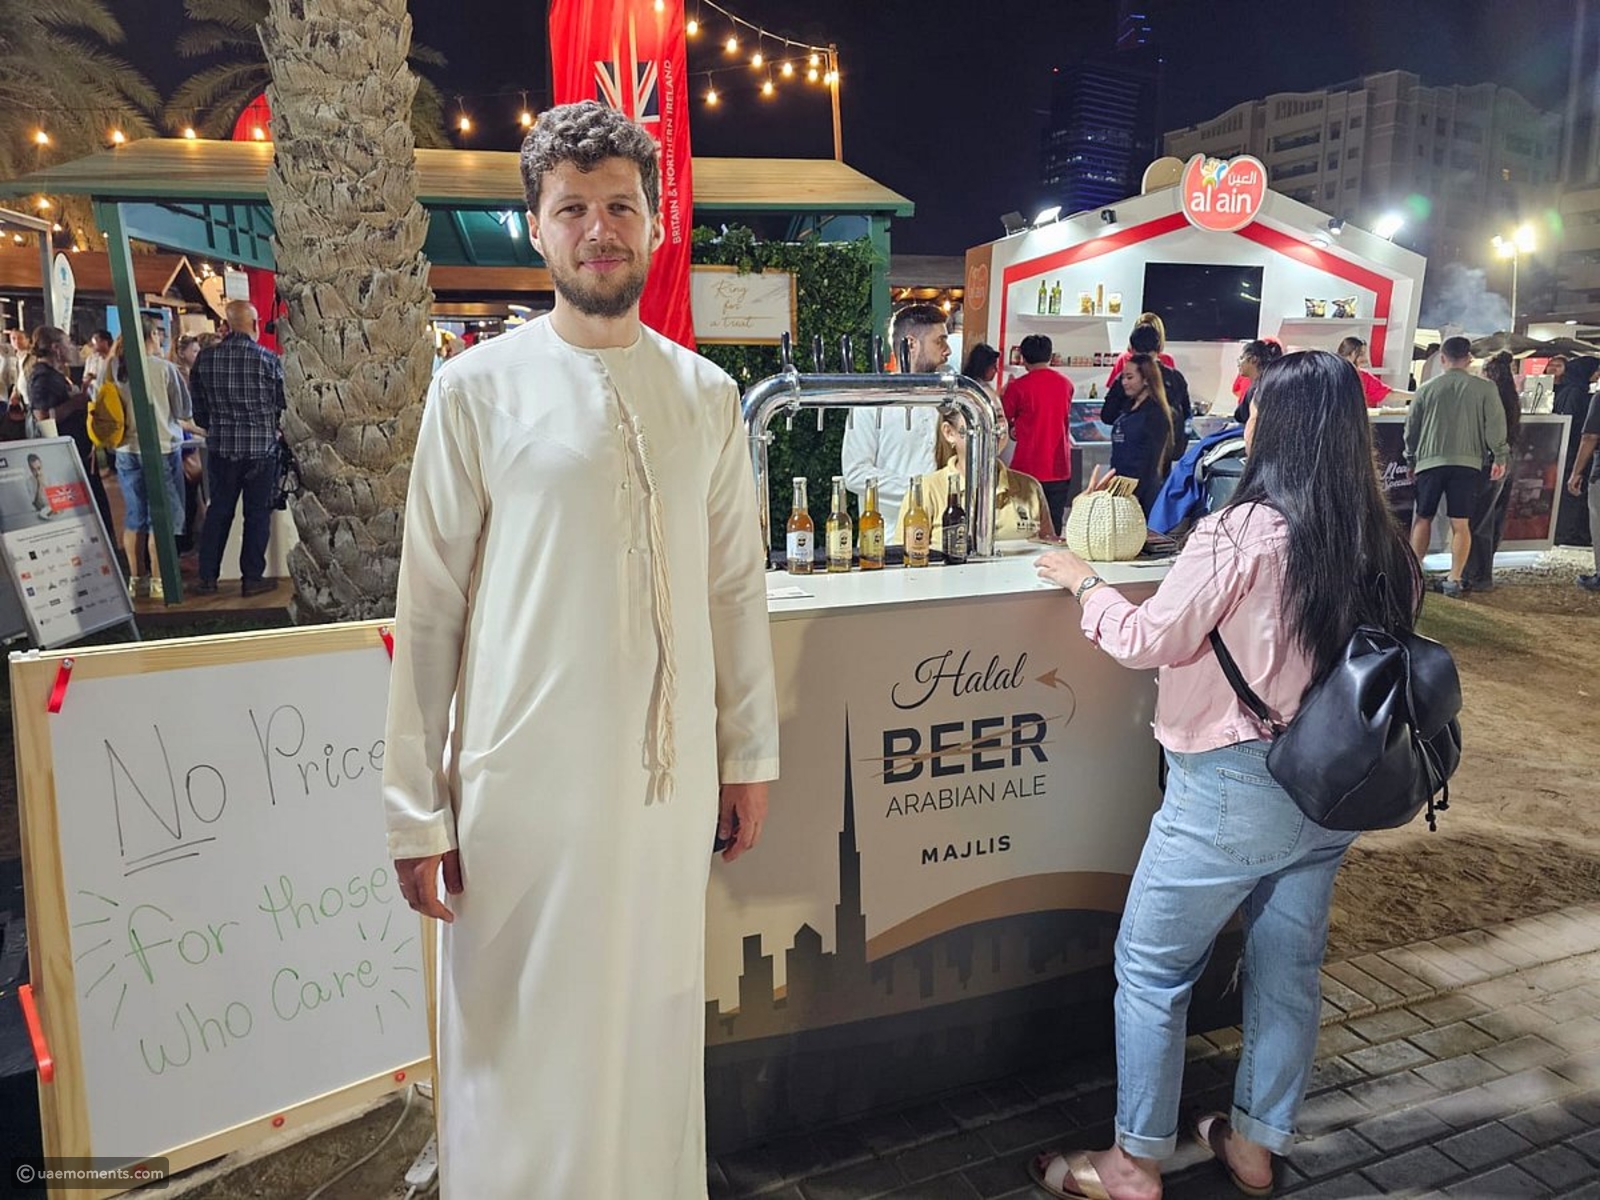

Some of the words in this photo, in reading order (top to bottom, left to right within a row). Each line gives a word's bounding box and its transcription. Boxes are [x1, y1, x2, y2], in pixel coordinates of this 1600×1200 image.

[663, 59, 674, 115] IRELAND
[666, 118, 677, 187] NORTHERN
[1227, 170, 1257, 186] العين
[667, 187, 678, 197] &
[1190, 183, 1213, 212] al
[1215, 187, 1253, 214] ain
[668, 199, 682, 245] BRITAIN
[891, 649, 1028, 710] Halal
[882, 712, 1049, 785] BEER
[104, 724, 227, 857] No
[248, 704, 386, 806] Price
[885, 781, 995, 818] ARABIAN
[1002, 774, 1047, 801] ALE
[920, 835, 1012, 866] MAJLIS
[257, 867, 394, 942] those
[271, 959, 380, 1021] Care
